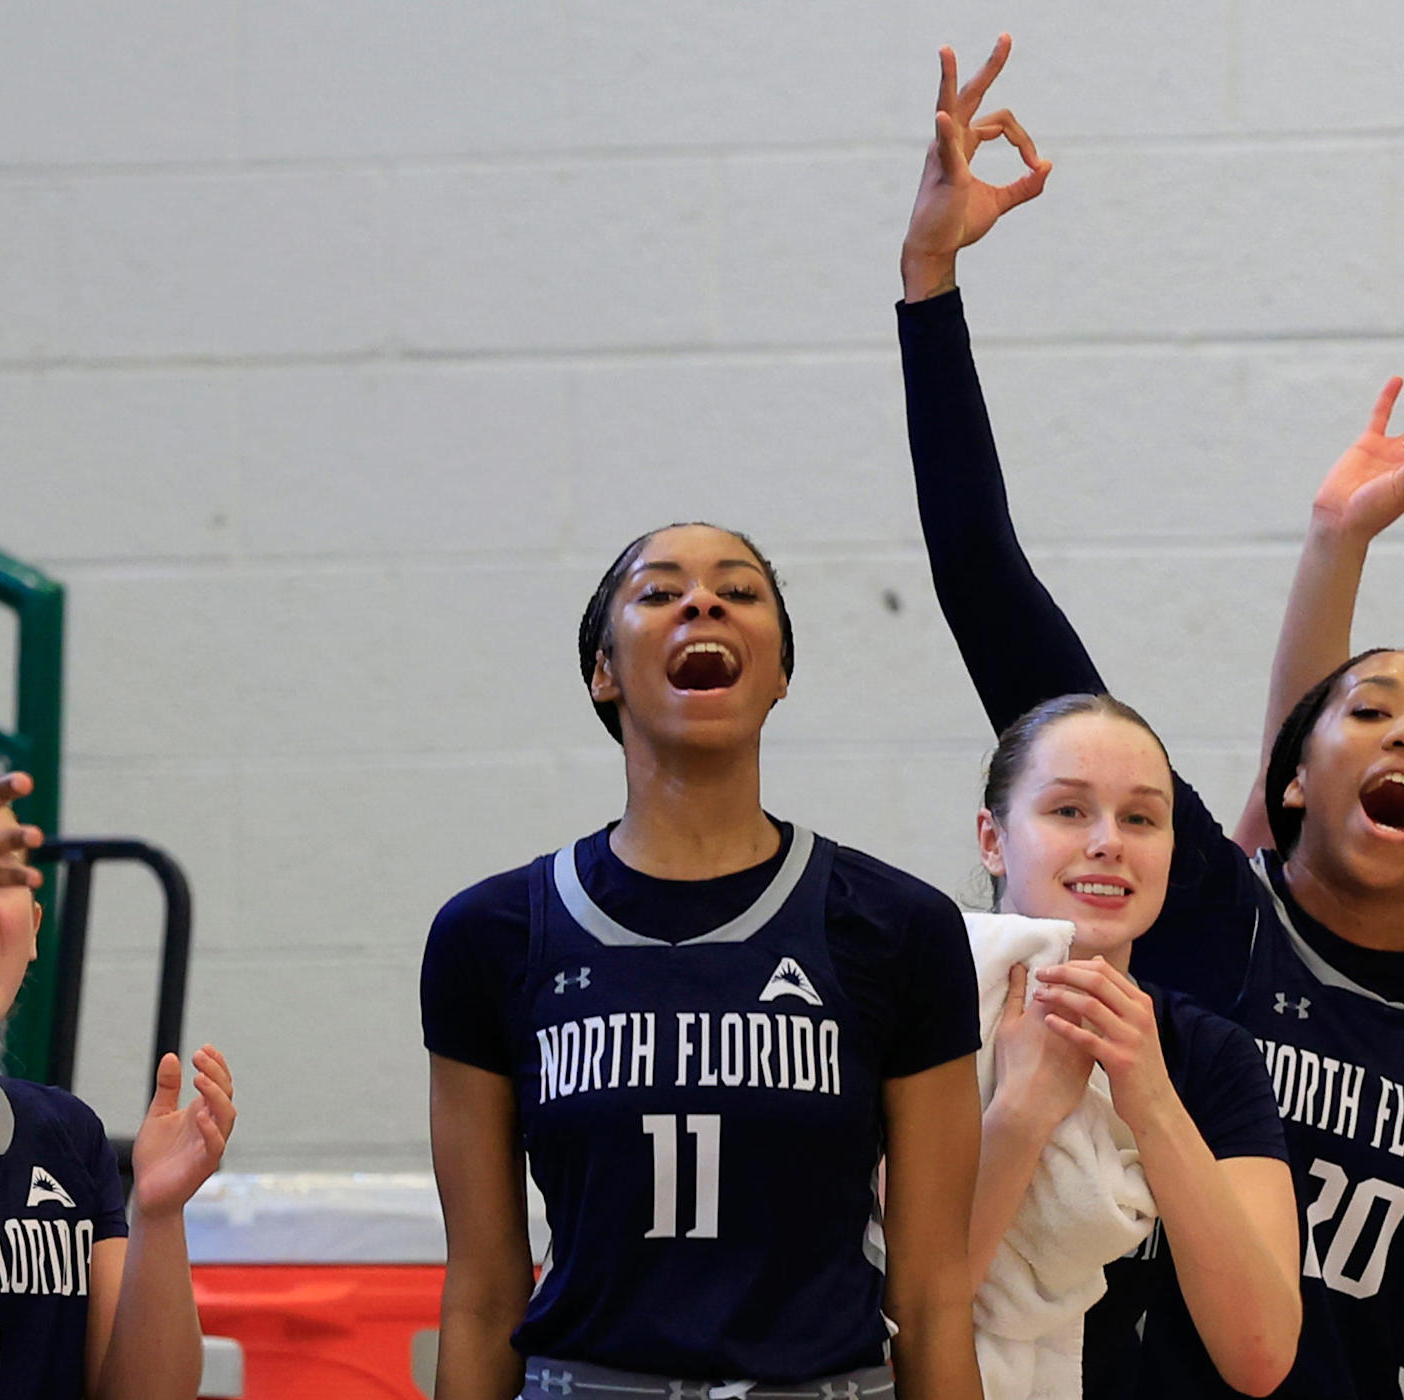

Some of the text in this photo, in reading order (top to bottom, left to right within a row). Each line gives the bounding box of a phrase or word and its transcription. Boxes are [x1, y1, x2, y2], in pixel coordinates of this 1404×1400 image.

[536, 1012, 841, 1104] NORTH FLORIDA
[642, 1114, 721, 1239] 11
